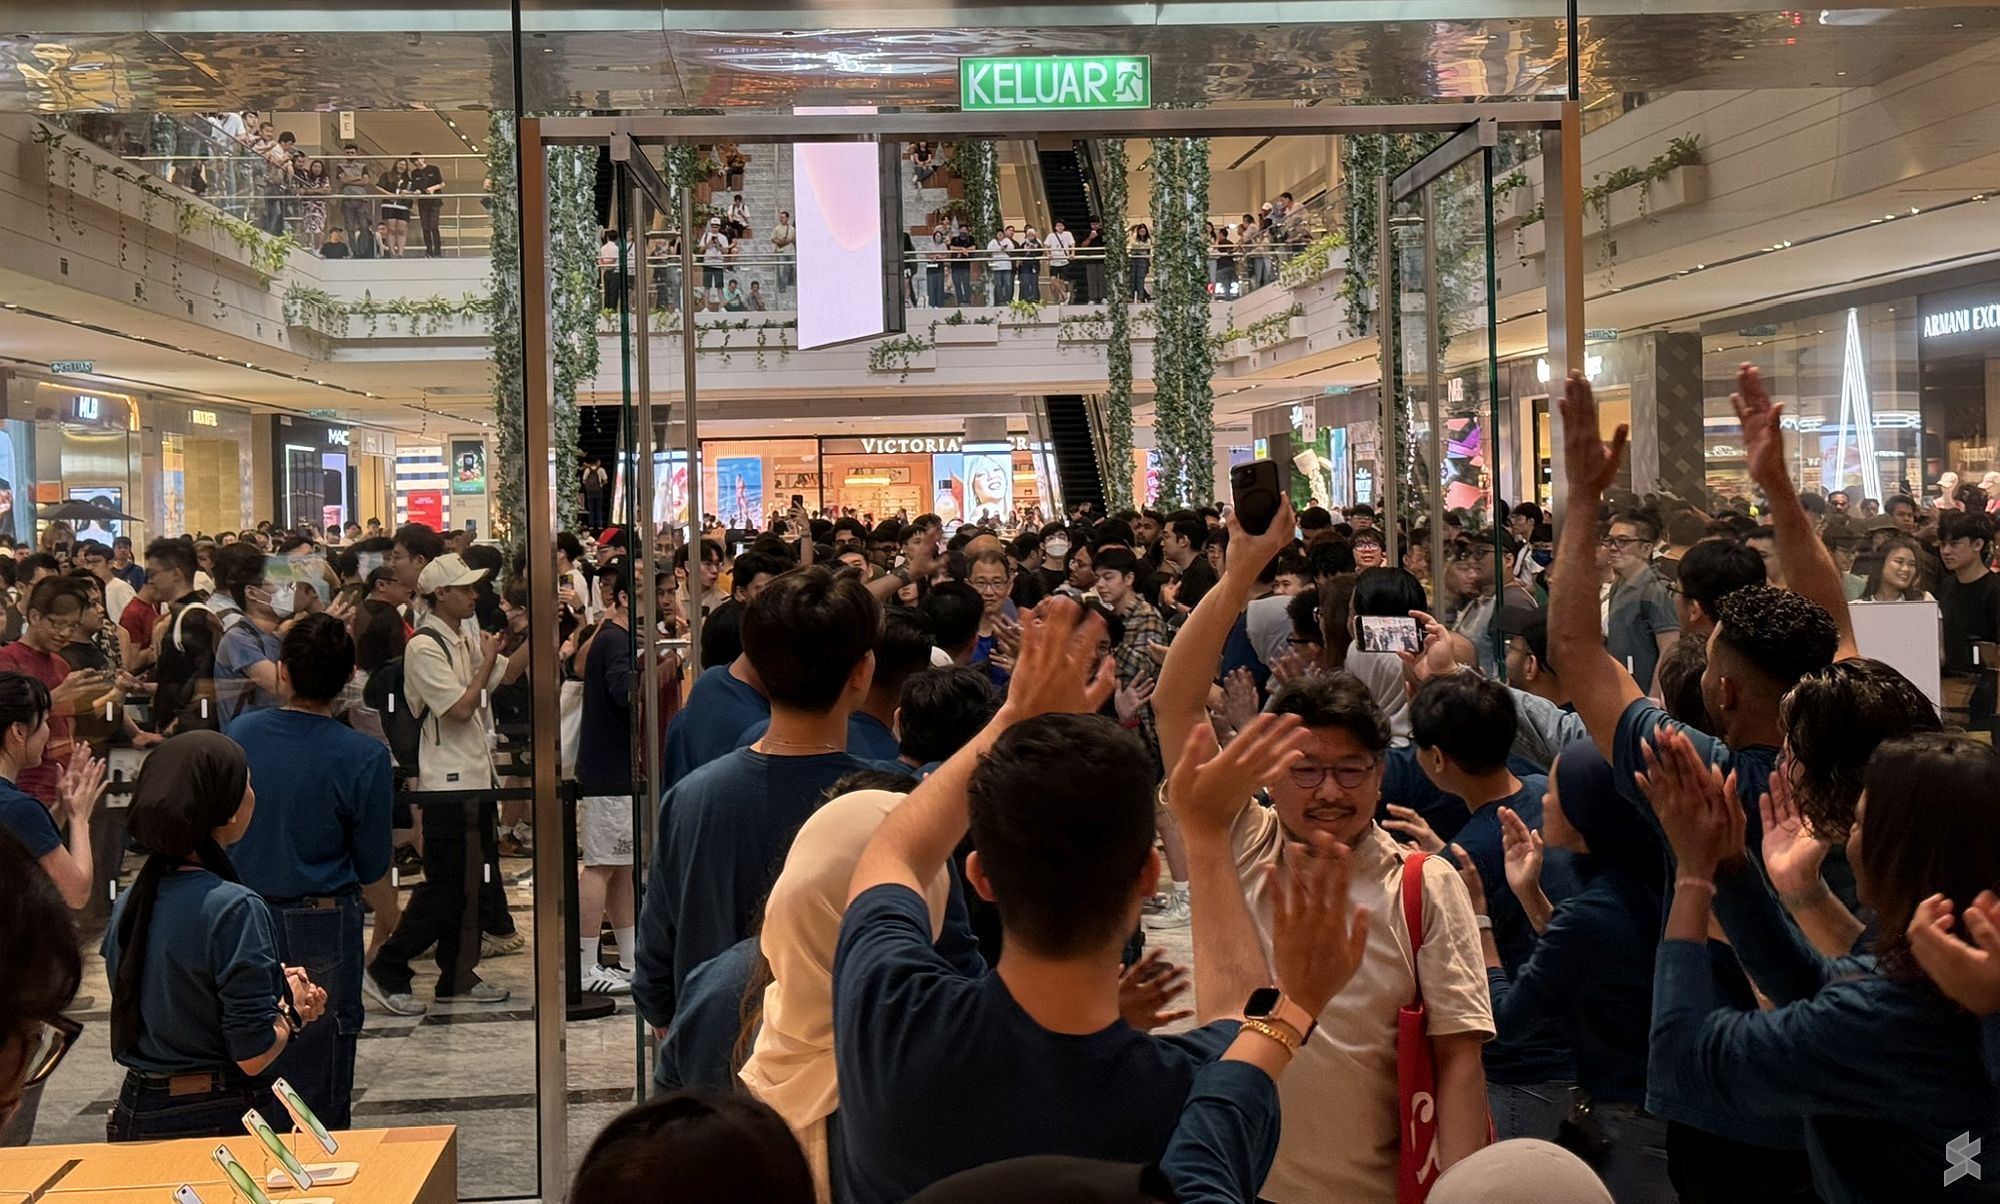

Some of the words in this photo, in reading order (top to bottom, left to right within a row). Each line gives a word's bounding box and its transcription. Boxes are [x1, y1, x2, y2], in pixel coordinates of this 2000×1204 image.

[968, 62, 1108, 104] KELUAR
[1923, 309, 1970, 338] ARMANI
[79, 396, 98, 419] MLB
[328, 428, 350, 446] MAC
[861, 437, 962, 453] VICTORIA'
